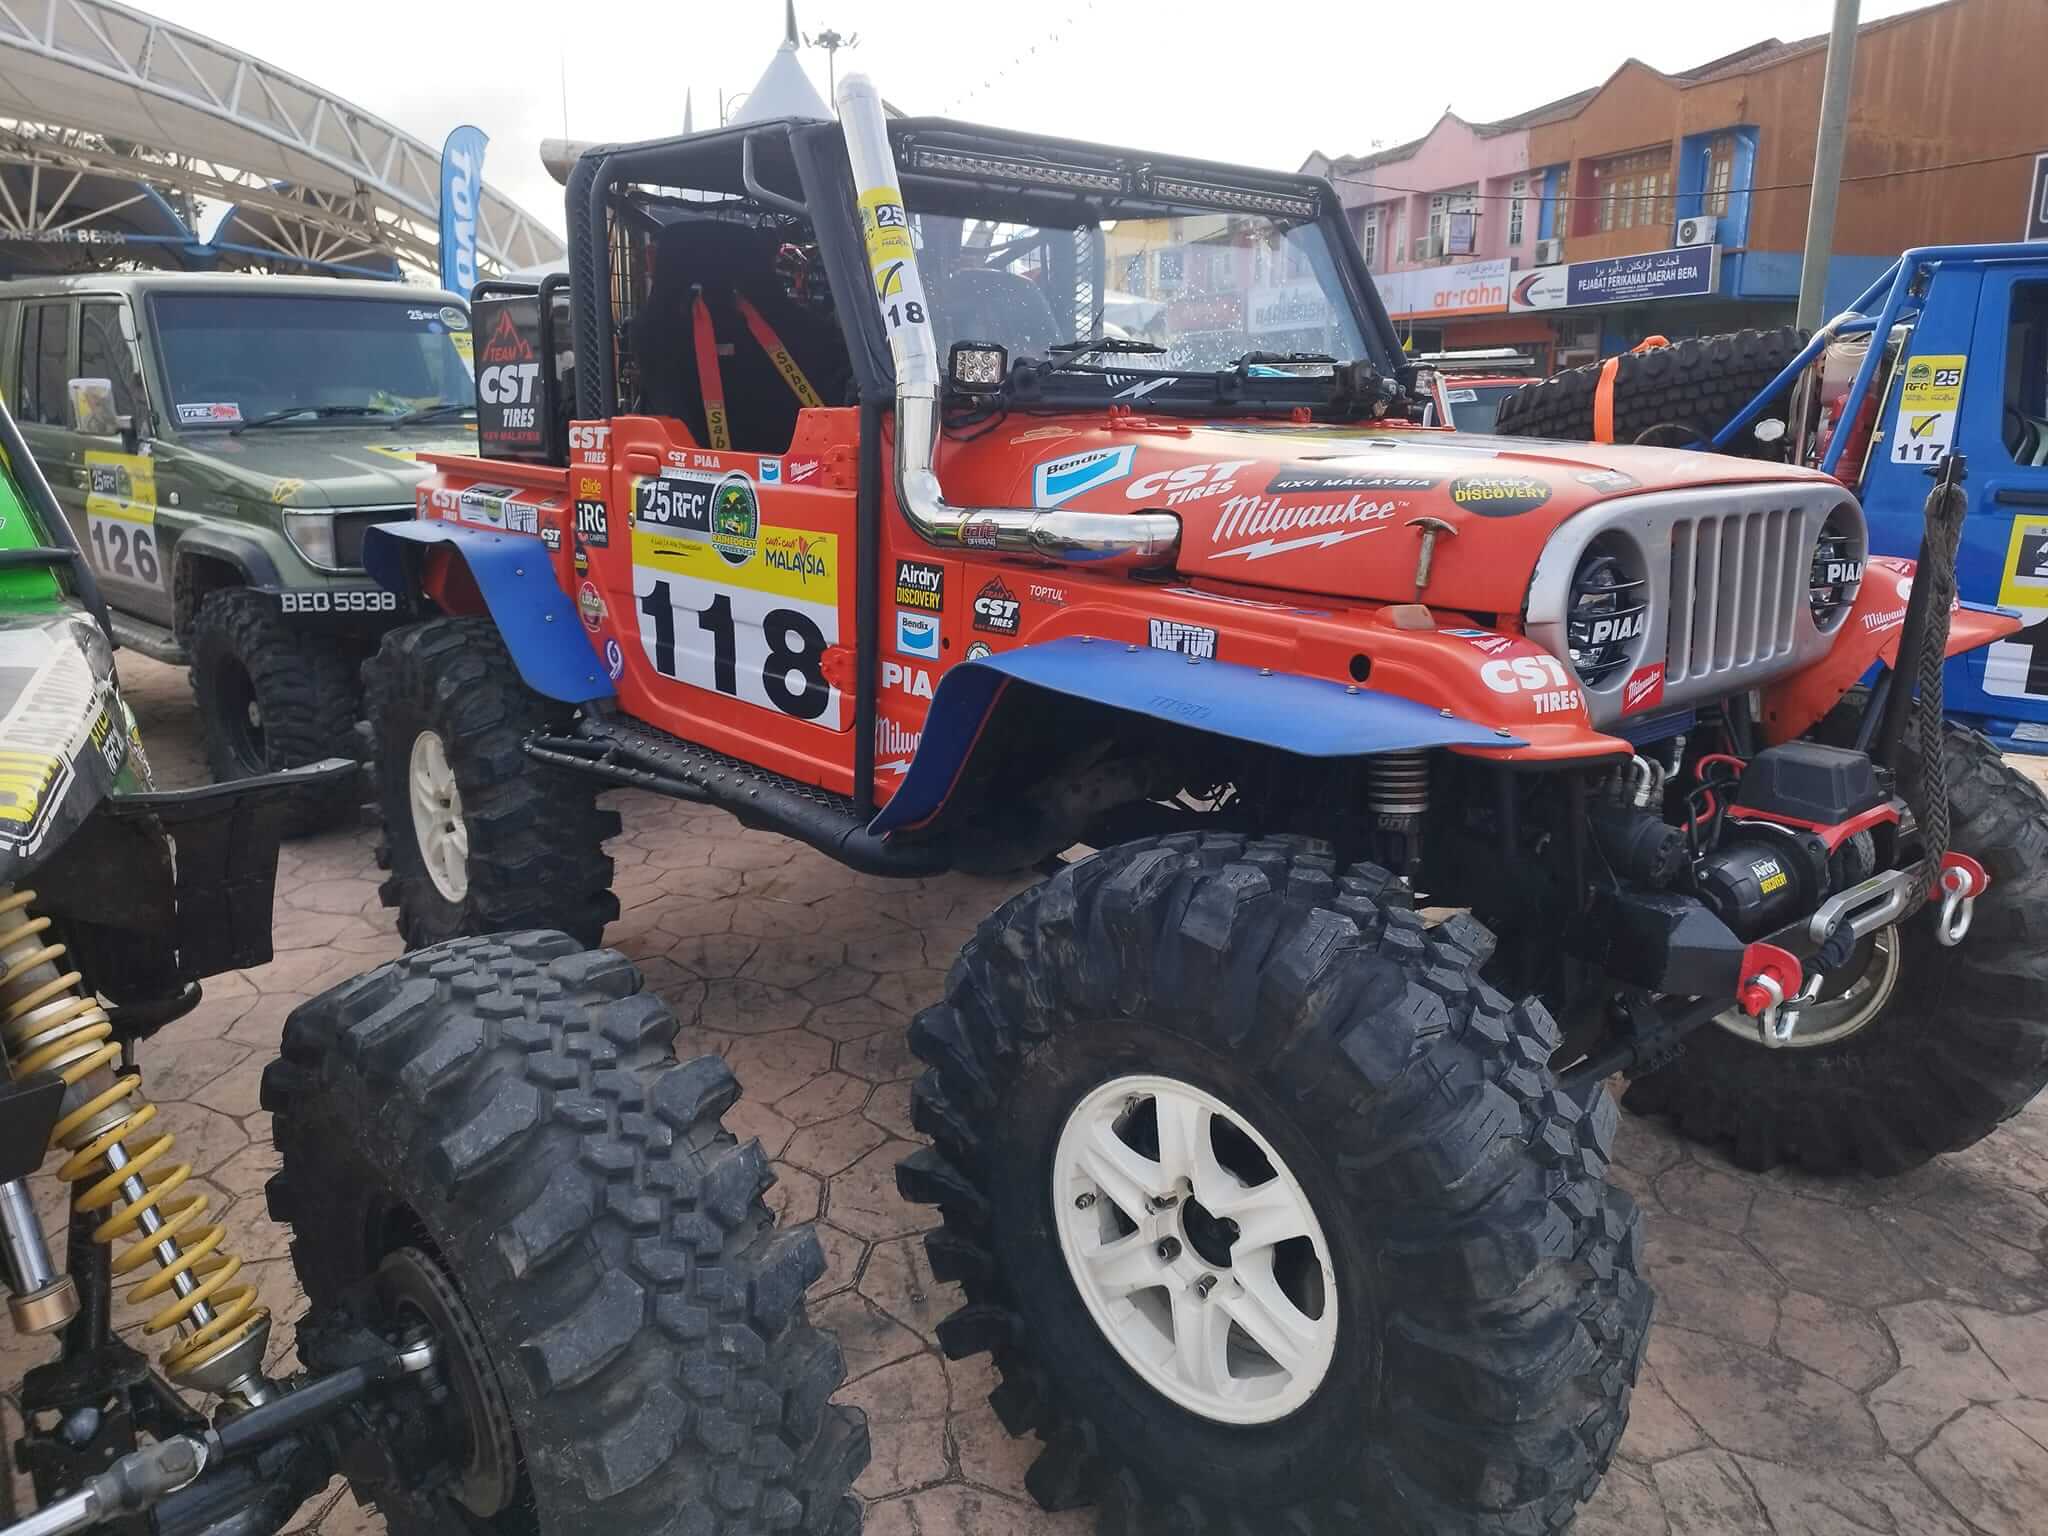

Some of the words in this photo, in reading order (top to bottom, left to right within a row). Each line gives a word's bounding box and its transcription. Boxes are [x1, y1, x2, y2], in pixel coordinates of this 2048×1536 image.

[877, 206, 905, 227] 25
[1578, 277, 1607, 291] PEJABAT
[1607, 272, 1647, 287] PERIKANAN
[1647, 269, 1676, 283] DAERAH
[1677, 266, 1698, 280] BERA
[881, 301, 926, 336] 18
[490, 346, 517, 361] TEAM
[480, 363, 539, 404] CST
[1905, 382, 1928, 391] RFC
[1935, 370, 1961, 387] 25
[503, 408, 535, 428] TIRES
[569, 427, 611, 449] CST
[584, 451, 606, 463] TIRES
[668, 450, 687, 462] CST
[694, 454, 720, 468] PIAA
[1897, 443, 1945, 461] 117
[1047, 452, 1109, 475] Bendix
[93, 468, 104, 490] 25
[1126, 460, 1252, 500] CST
[1277, 479, 1319, 488] 4X4
[1322, 478, 1431, 487] MALAYSIA
[431, 487, 459, 510] CST
[643, 481, 670, 522] 25
[1165, 480, 1237, 506] TIRES
[1455, 487, 1548, 502] DISCOVERY
[578, 503, 607, 533] iRG
[1211, 494, 1396, 543] Milwaukee
[541, 528, 561, 541] CST
[92, 520, 158, 584] 126
[765, 548, 826, 582] MALAYSIA
[1827, 561, 1863, 583] PIAA
[899, 563, 941, 591] Airdry
[333, 591, 396, 611] 5938
[896, 586, 941, 610] DISCOVERY
[1029, 584, 1064, 600] TOPTUL
[974, 598, 1020, 618] CST
[902, 616, 929, 631] Bendix
[989, 617, 1014, 628] TIRES
[1591, 613, 1646, 644] PIAA
[639, 579, 830, 720] 118
[1150, 619, 1215, 659] RAPTOR
[882, 661, 944, 699] PIA
[1481, 654, 1568, 693] CST
[1533, 691, 1578, 714] TIRES
[1752, 858, 1781, 879] Airdry
